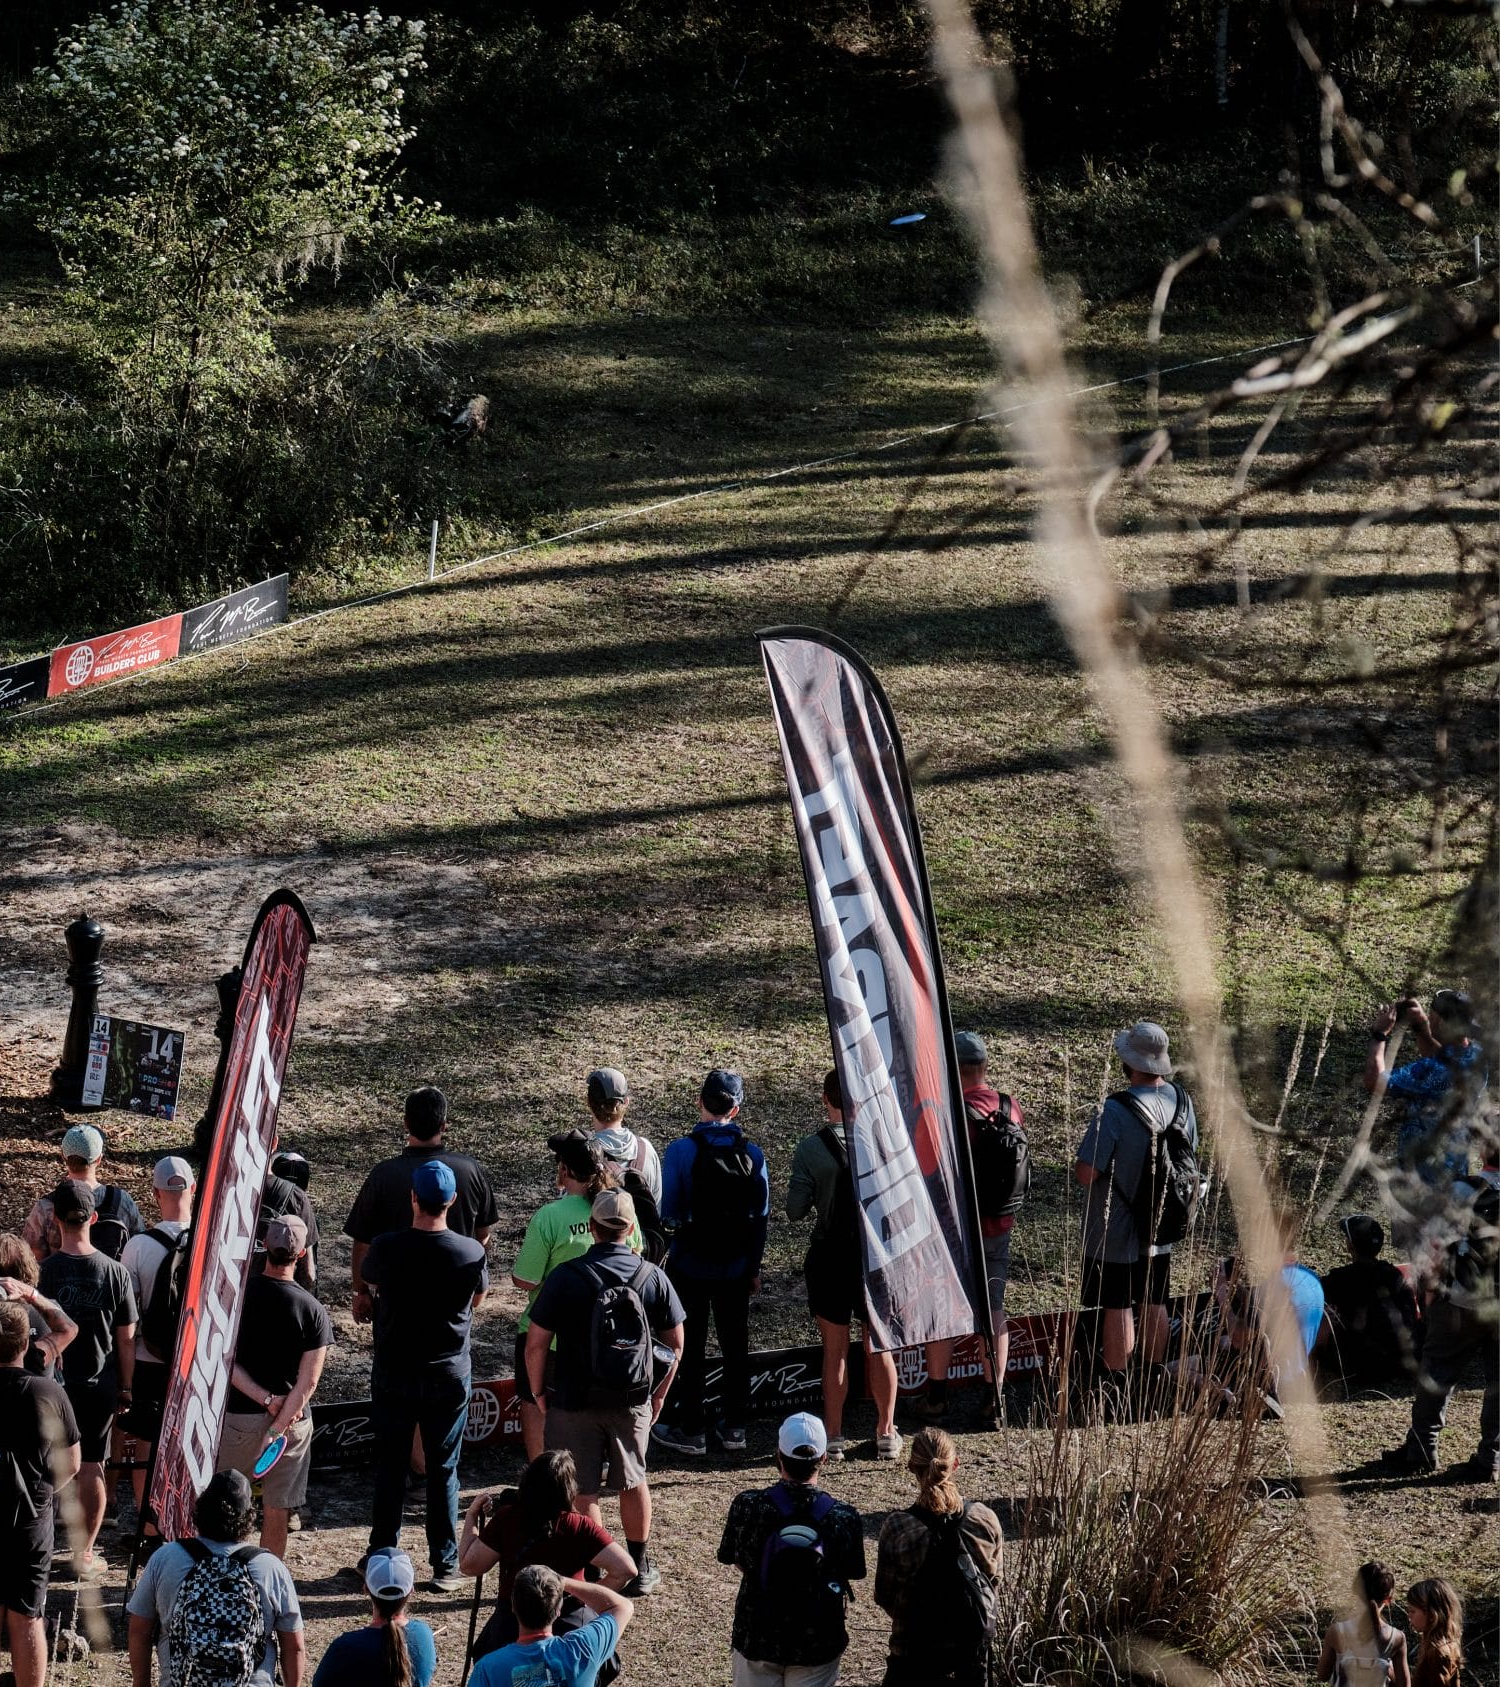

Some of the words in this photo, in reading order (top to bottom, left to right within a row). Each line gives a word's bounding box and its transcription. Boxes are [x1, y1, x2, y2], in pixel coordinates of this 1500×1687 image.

[94, 657, 136, 678] BUILDERS
[138, 650, 160, 665] CLUB
[96, 1020, 107, 1033] 14
[148, 1029, 174, 1062] 14
[183, 996, 281, 1494] DISCRAFT
